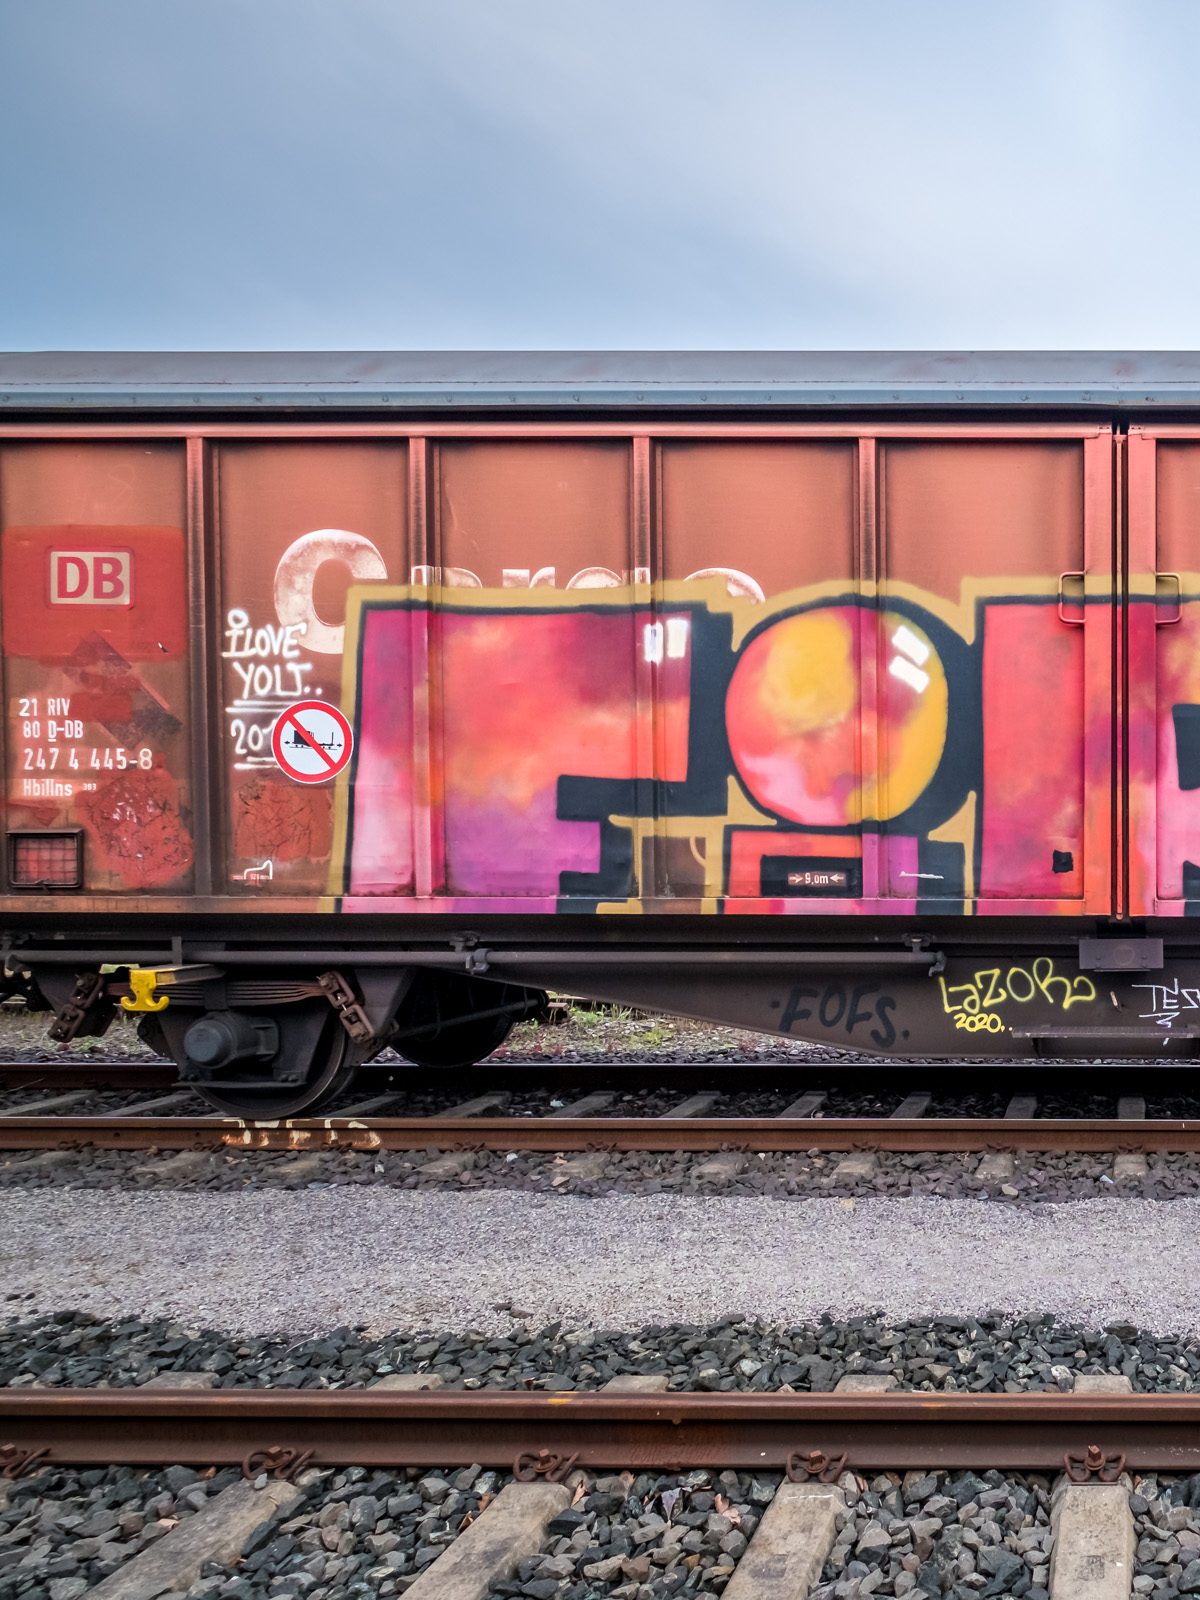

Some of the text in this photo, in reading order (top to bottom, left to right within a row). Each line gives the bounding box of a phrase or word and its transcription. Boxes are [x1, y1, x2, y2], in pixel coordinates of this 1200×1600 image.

[57, 556, 125, 599] DB
[18, 697, 71, 717] 21 RIV
[23, 719, 84, 742] 80 D-DB
[23, 747, 153, 771] 247 4 445-8
[23, 778, 74, 797] Hbillns
